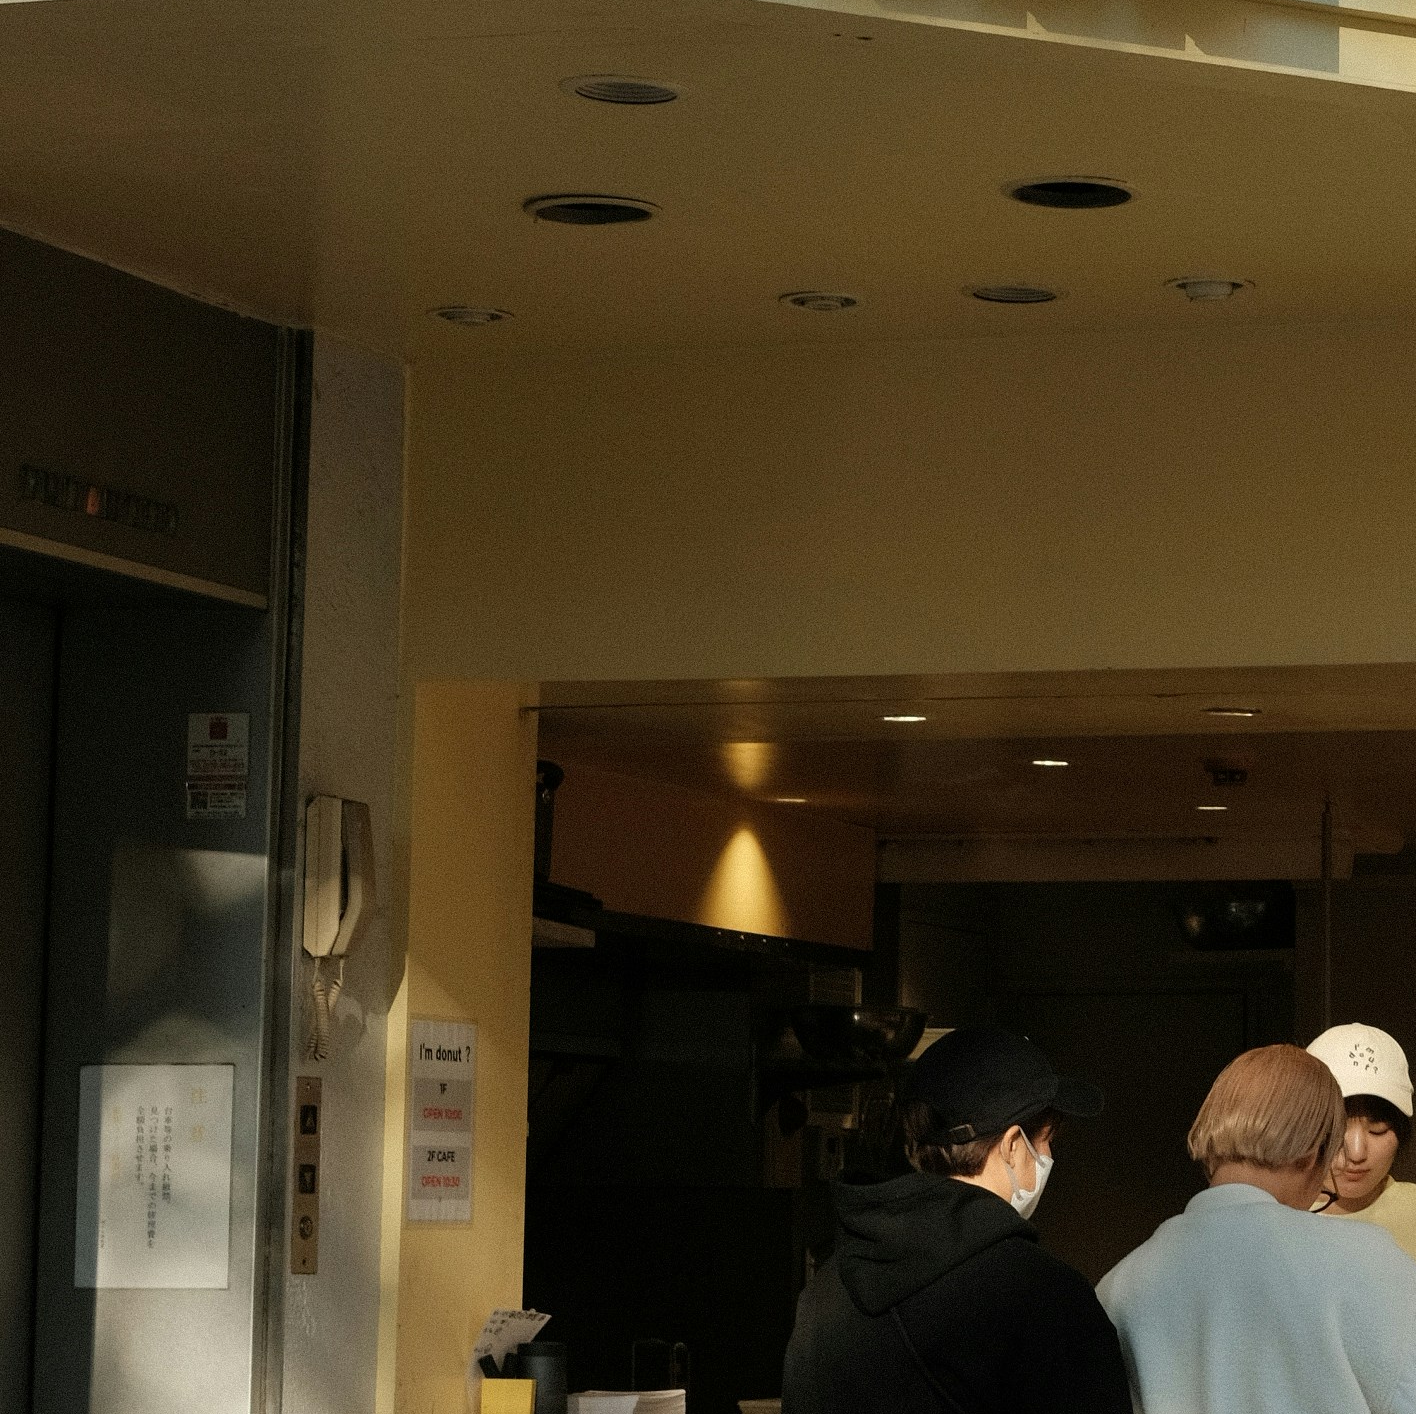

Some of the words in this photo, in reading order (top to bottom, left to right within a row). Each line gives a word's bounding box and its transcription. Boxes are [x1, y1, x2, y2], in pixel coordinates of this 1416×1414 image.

[419, 1043, 433, 1061] I'm
[435, 1044, 462, 1062] donut
[465, 1045, 471, 1063] ?
[423, 1107, 443, 1120] OPEN
[427, 1150, 436, 1162] 2F
[437, 1150, 455, 1163] CAFE
[421, 1176, 441, 1187] OPEN
